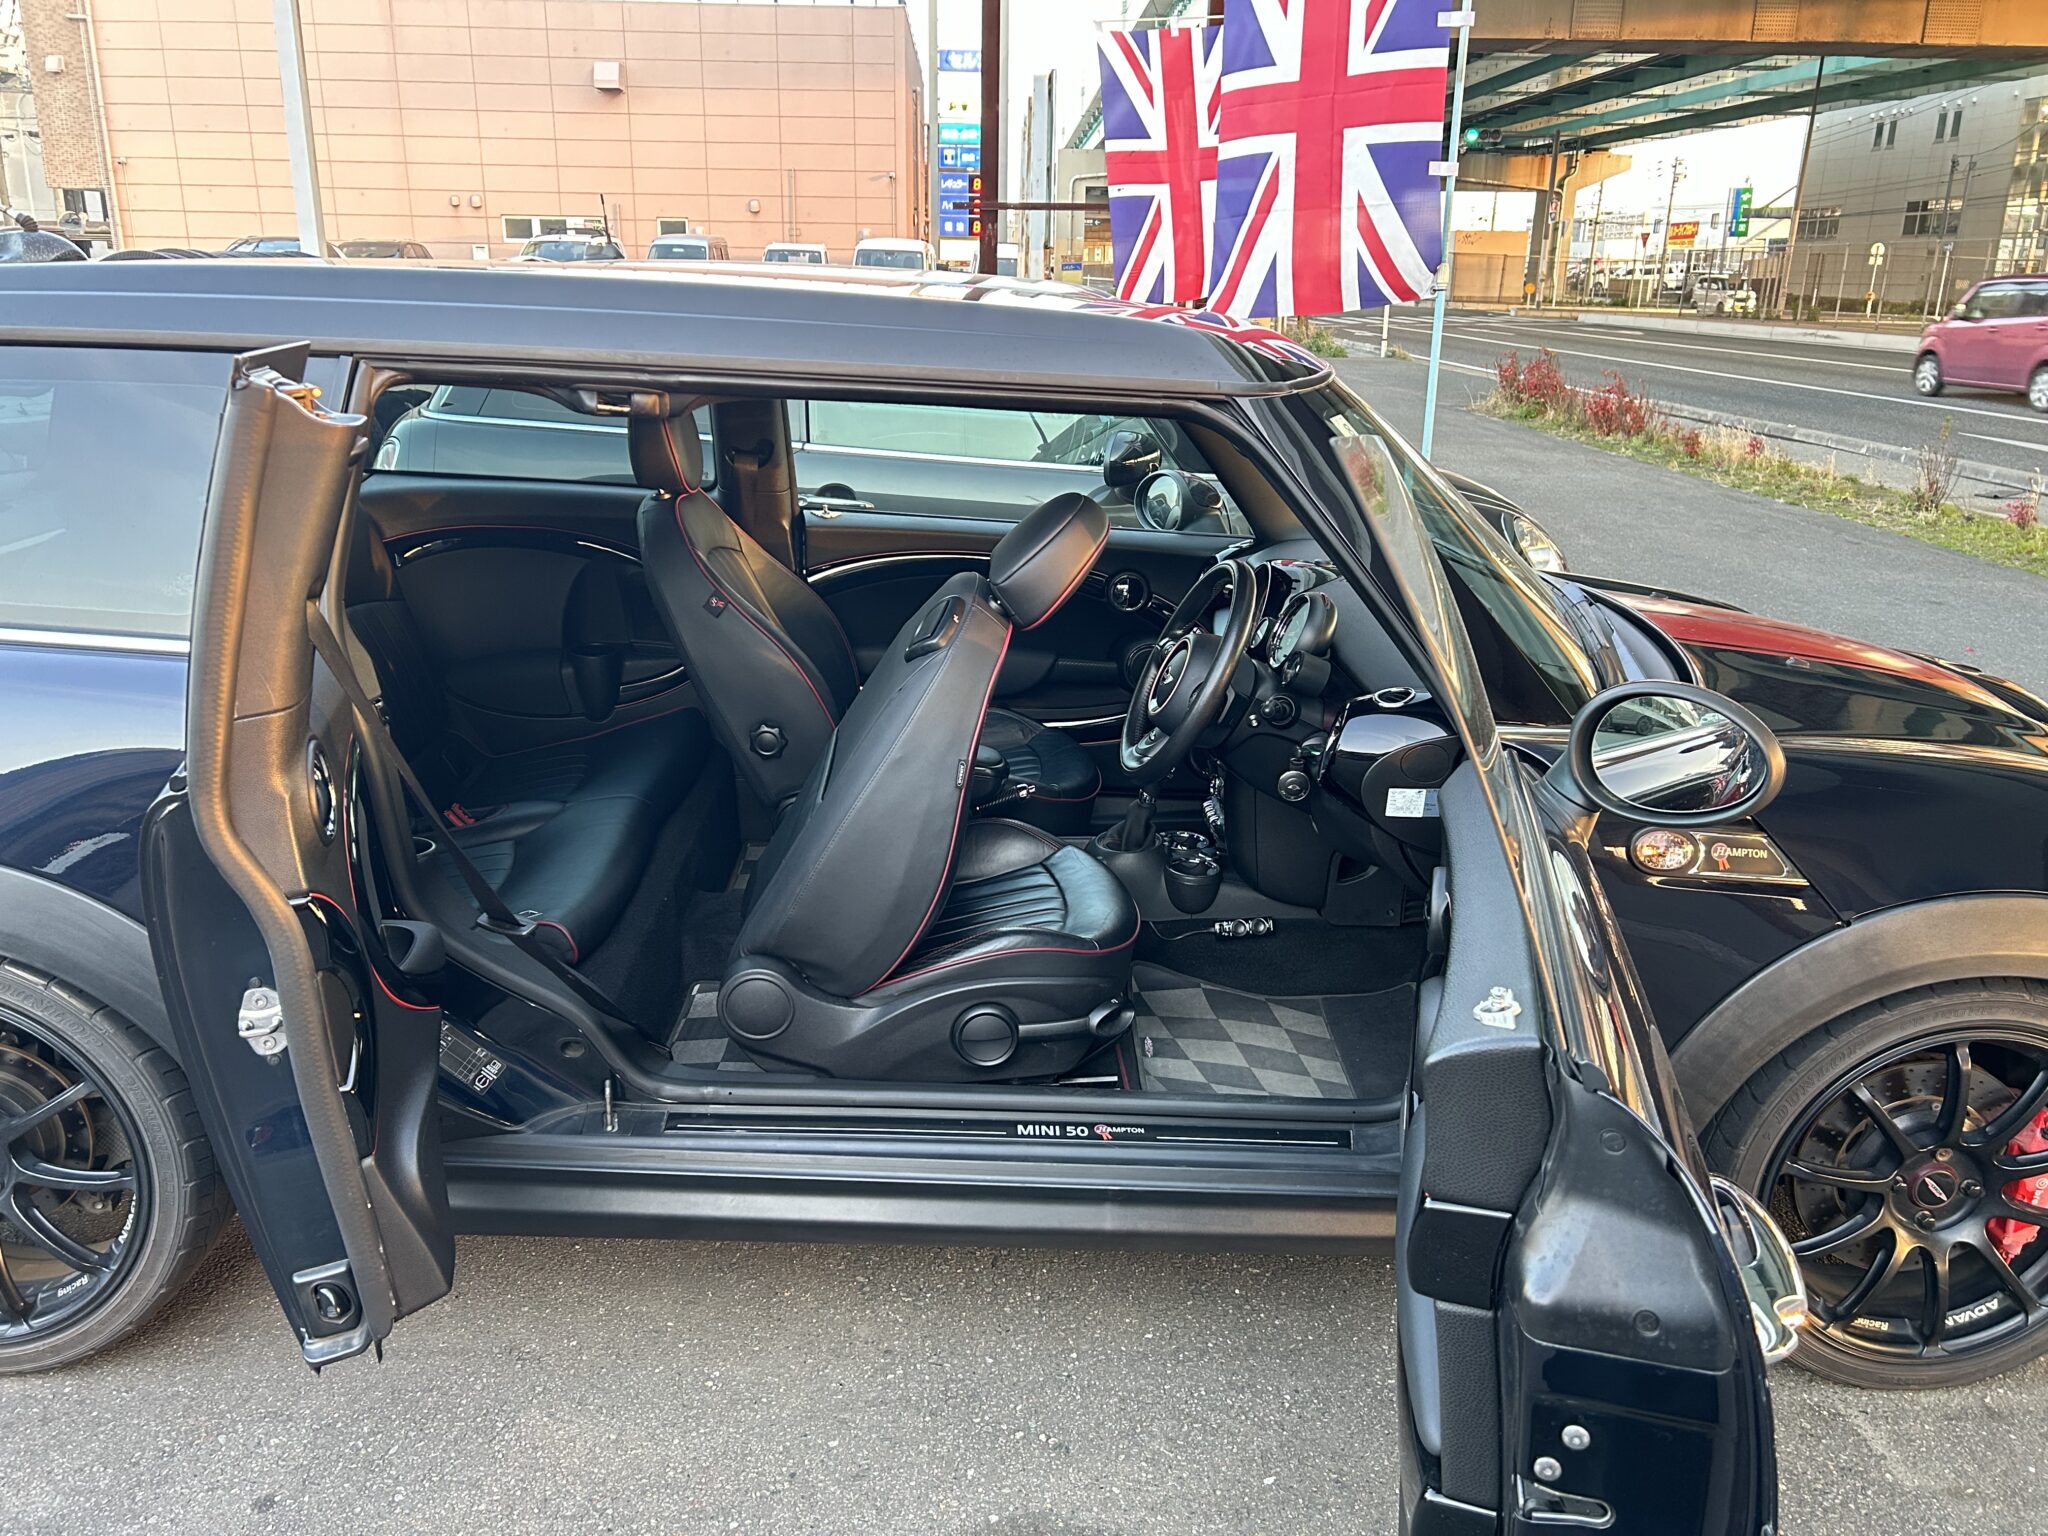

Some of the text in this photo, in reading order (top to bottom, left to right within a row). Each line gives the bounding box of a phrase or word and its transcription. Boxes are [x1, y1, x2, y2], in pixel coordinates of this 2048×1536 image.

[948, 51, 981, 70] セル
[1713, 845, 1768, 859] HAMPTON
[1016, 1124, 1146, 1137] MINI 50 HAMPTON
[57, 1273, 90, 1298] Racing
